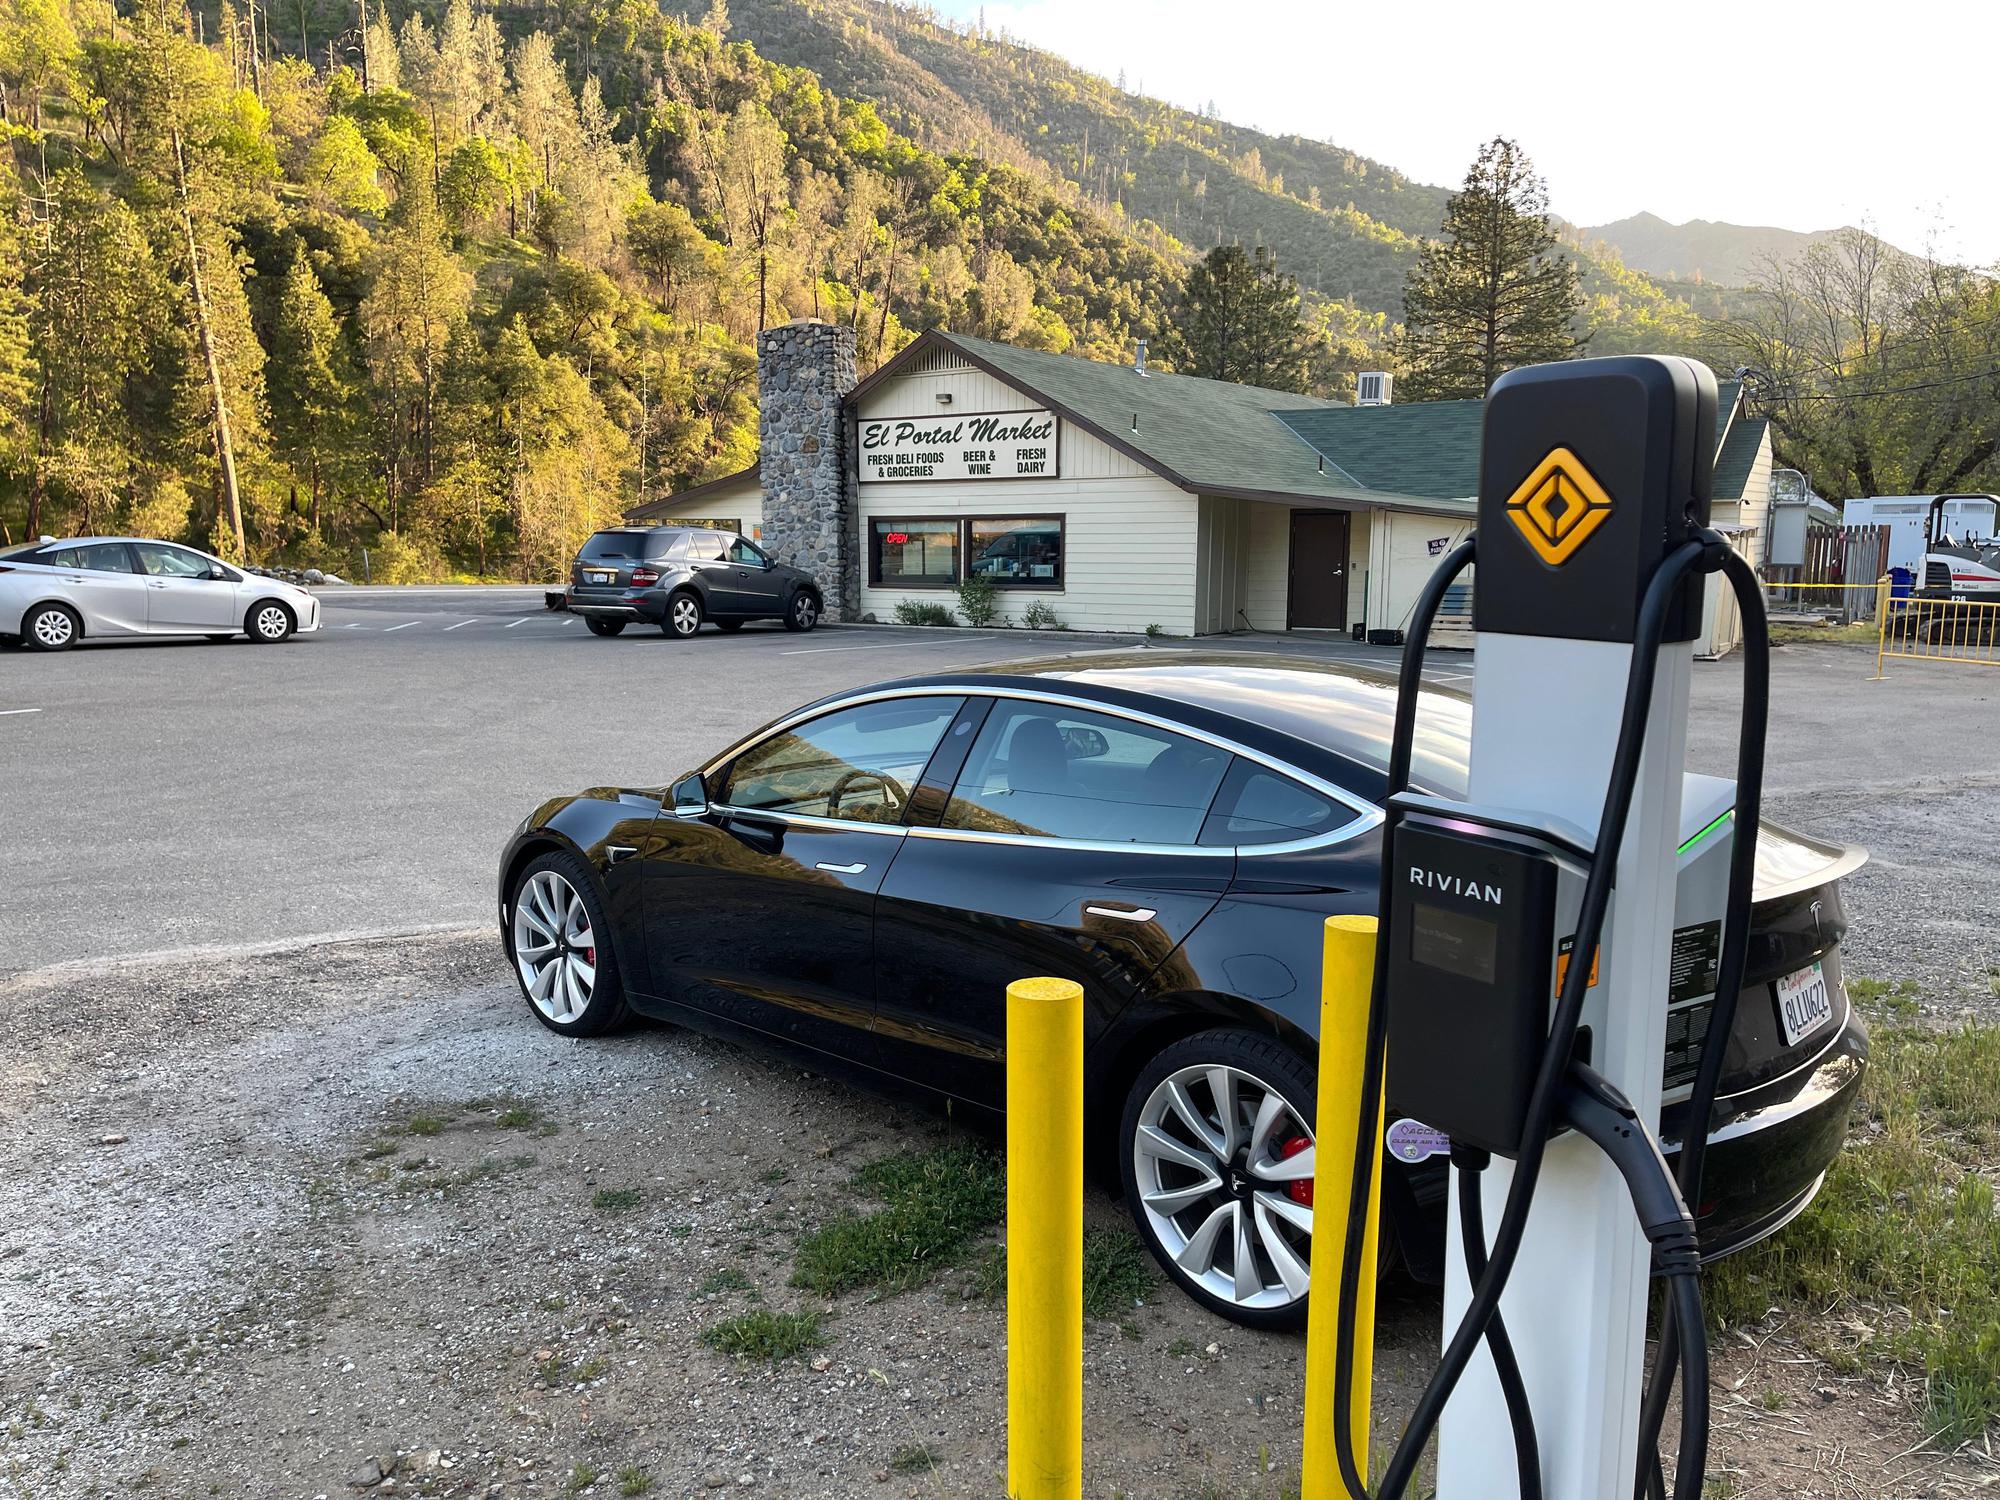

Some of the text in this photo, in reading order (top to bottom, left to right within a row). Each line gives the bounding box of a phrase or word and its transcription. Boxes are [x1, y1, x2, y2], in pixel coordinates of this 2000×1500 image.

[863, 416, 1052, 449] El Portal Market
[867, 452, 944, 465] FRESH DELI FOODS
[963, 450, 996, 462] BEER &
[1016, 448, 1046, 460] FRESH
[878, 465, 934, 477] & GROCERIES
[968, 464, 991, 475] WINE
[1017, 461, 1045, 473] DAIRY
[887, 532, 908, 544] OPEN
[1409, 867, 1502, 905] RIVIAN
[1785, 979, 1829, 1033] 8LLU622
